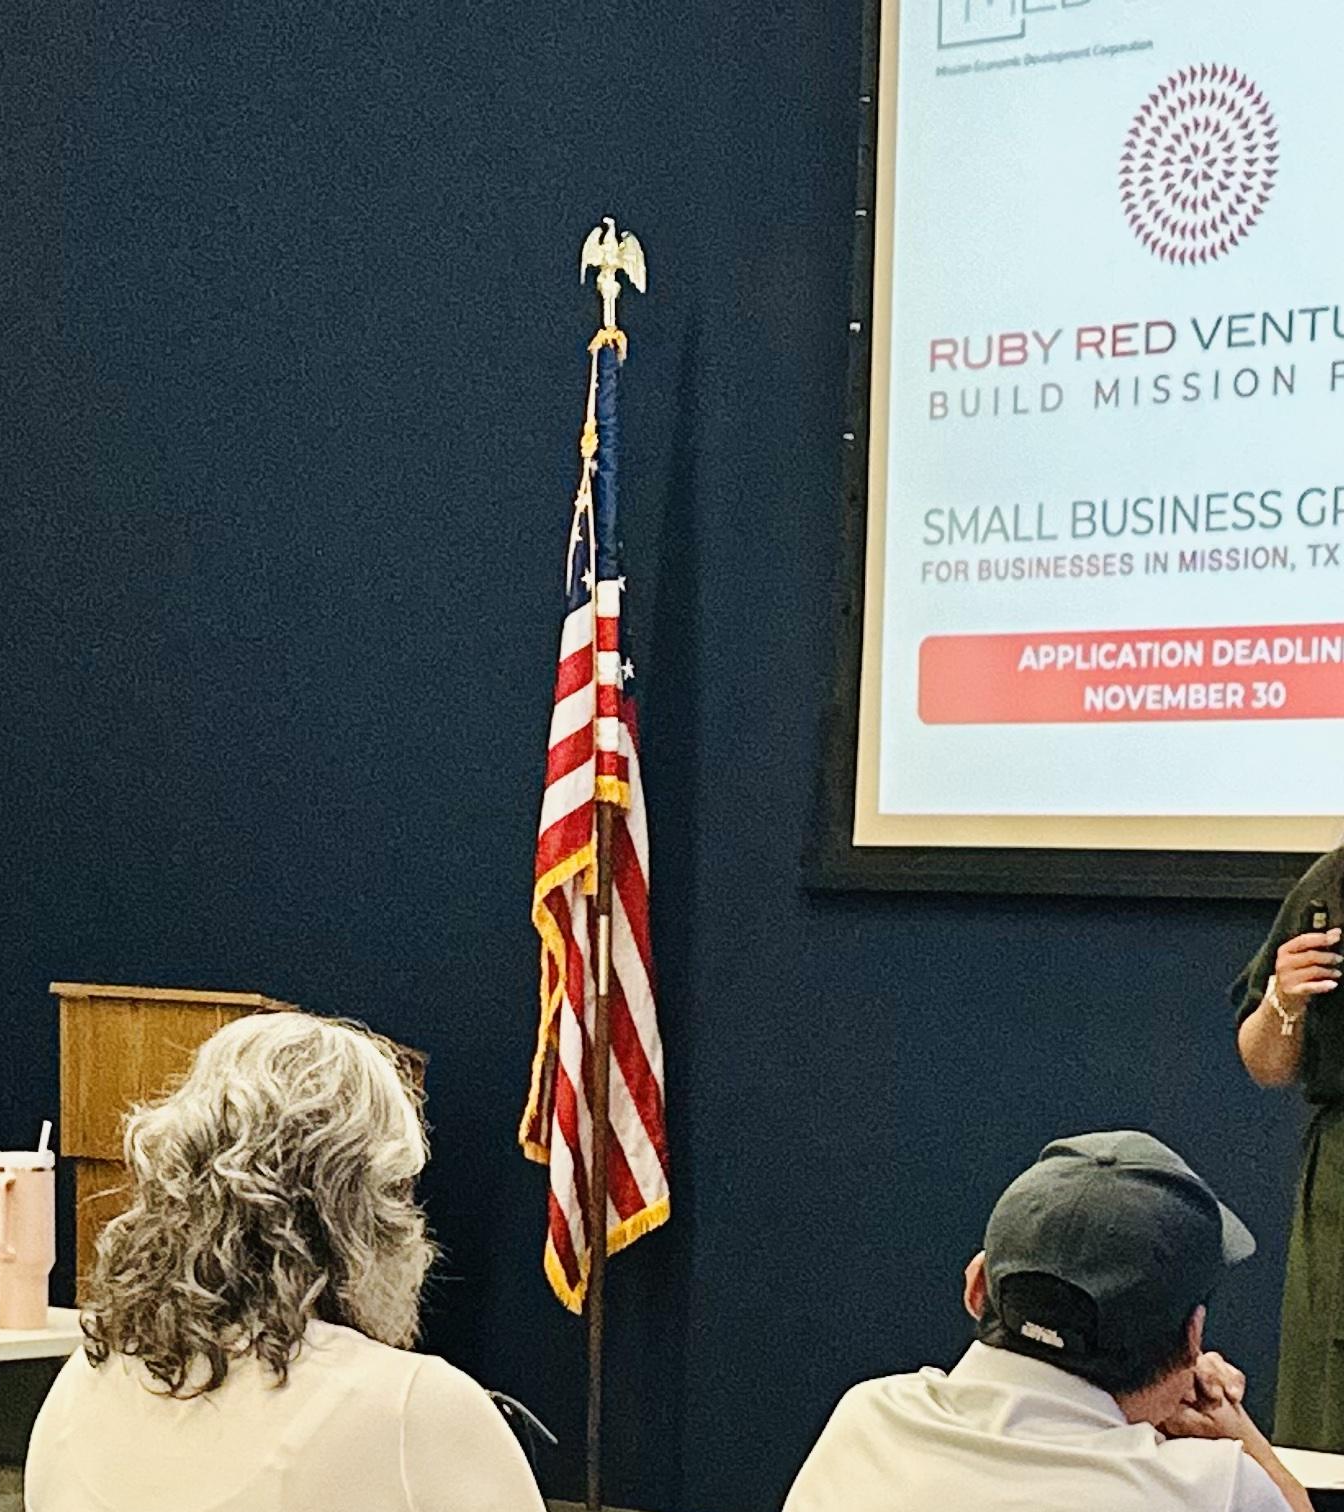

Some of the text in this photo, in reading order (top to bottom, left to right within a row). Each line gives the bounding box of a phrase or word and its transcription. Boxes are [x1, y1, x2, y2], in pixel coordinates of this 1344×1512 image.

[929, 329, 1063, 373] RUBY
[1075, 321, 1177, 361] RED
[928, 383, 1064, 421] BUILD
[1093, 364, 1296, 409] MISSION
[922, 502, 1058, 547] SMALL
[1071, 490, 1283, 540] BUSINESS
[921, 543, 1341, 584] FOR BUSINESSES IN MISSION, TX
[1017, 639, 1204, 672] APPLICATION
[1083, 682, 1287, 713] NOVEMBER 30
